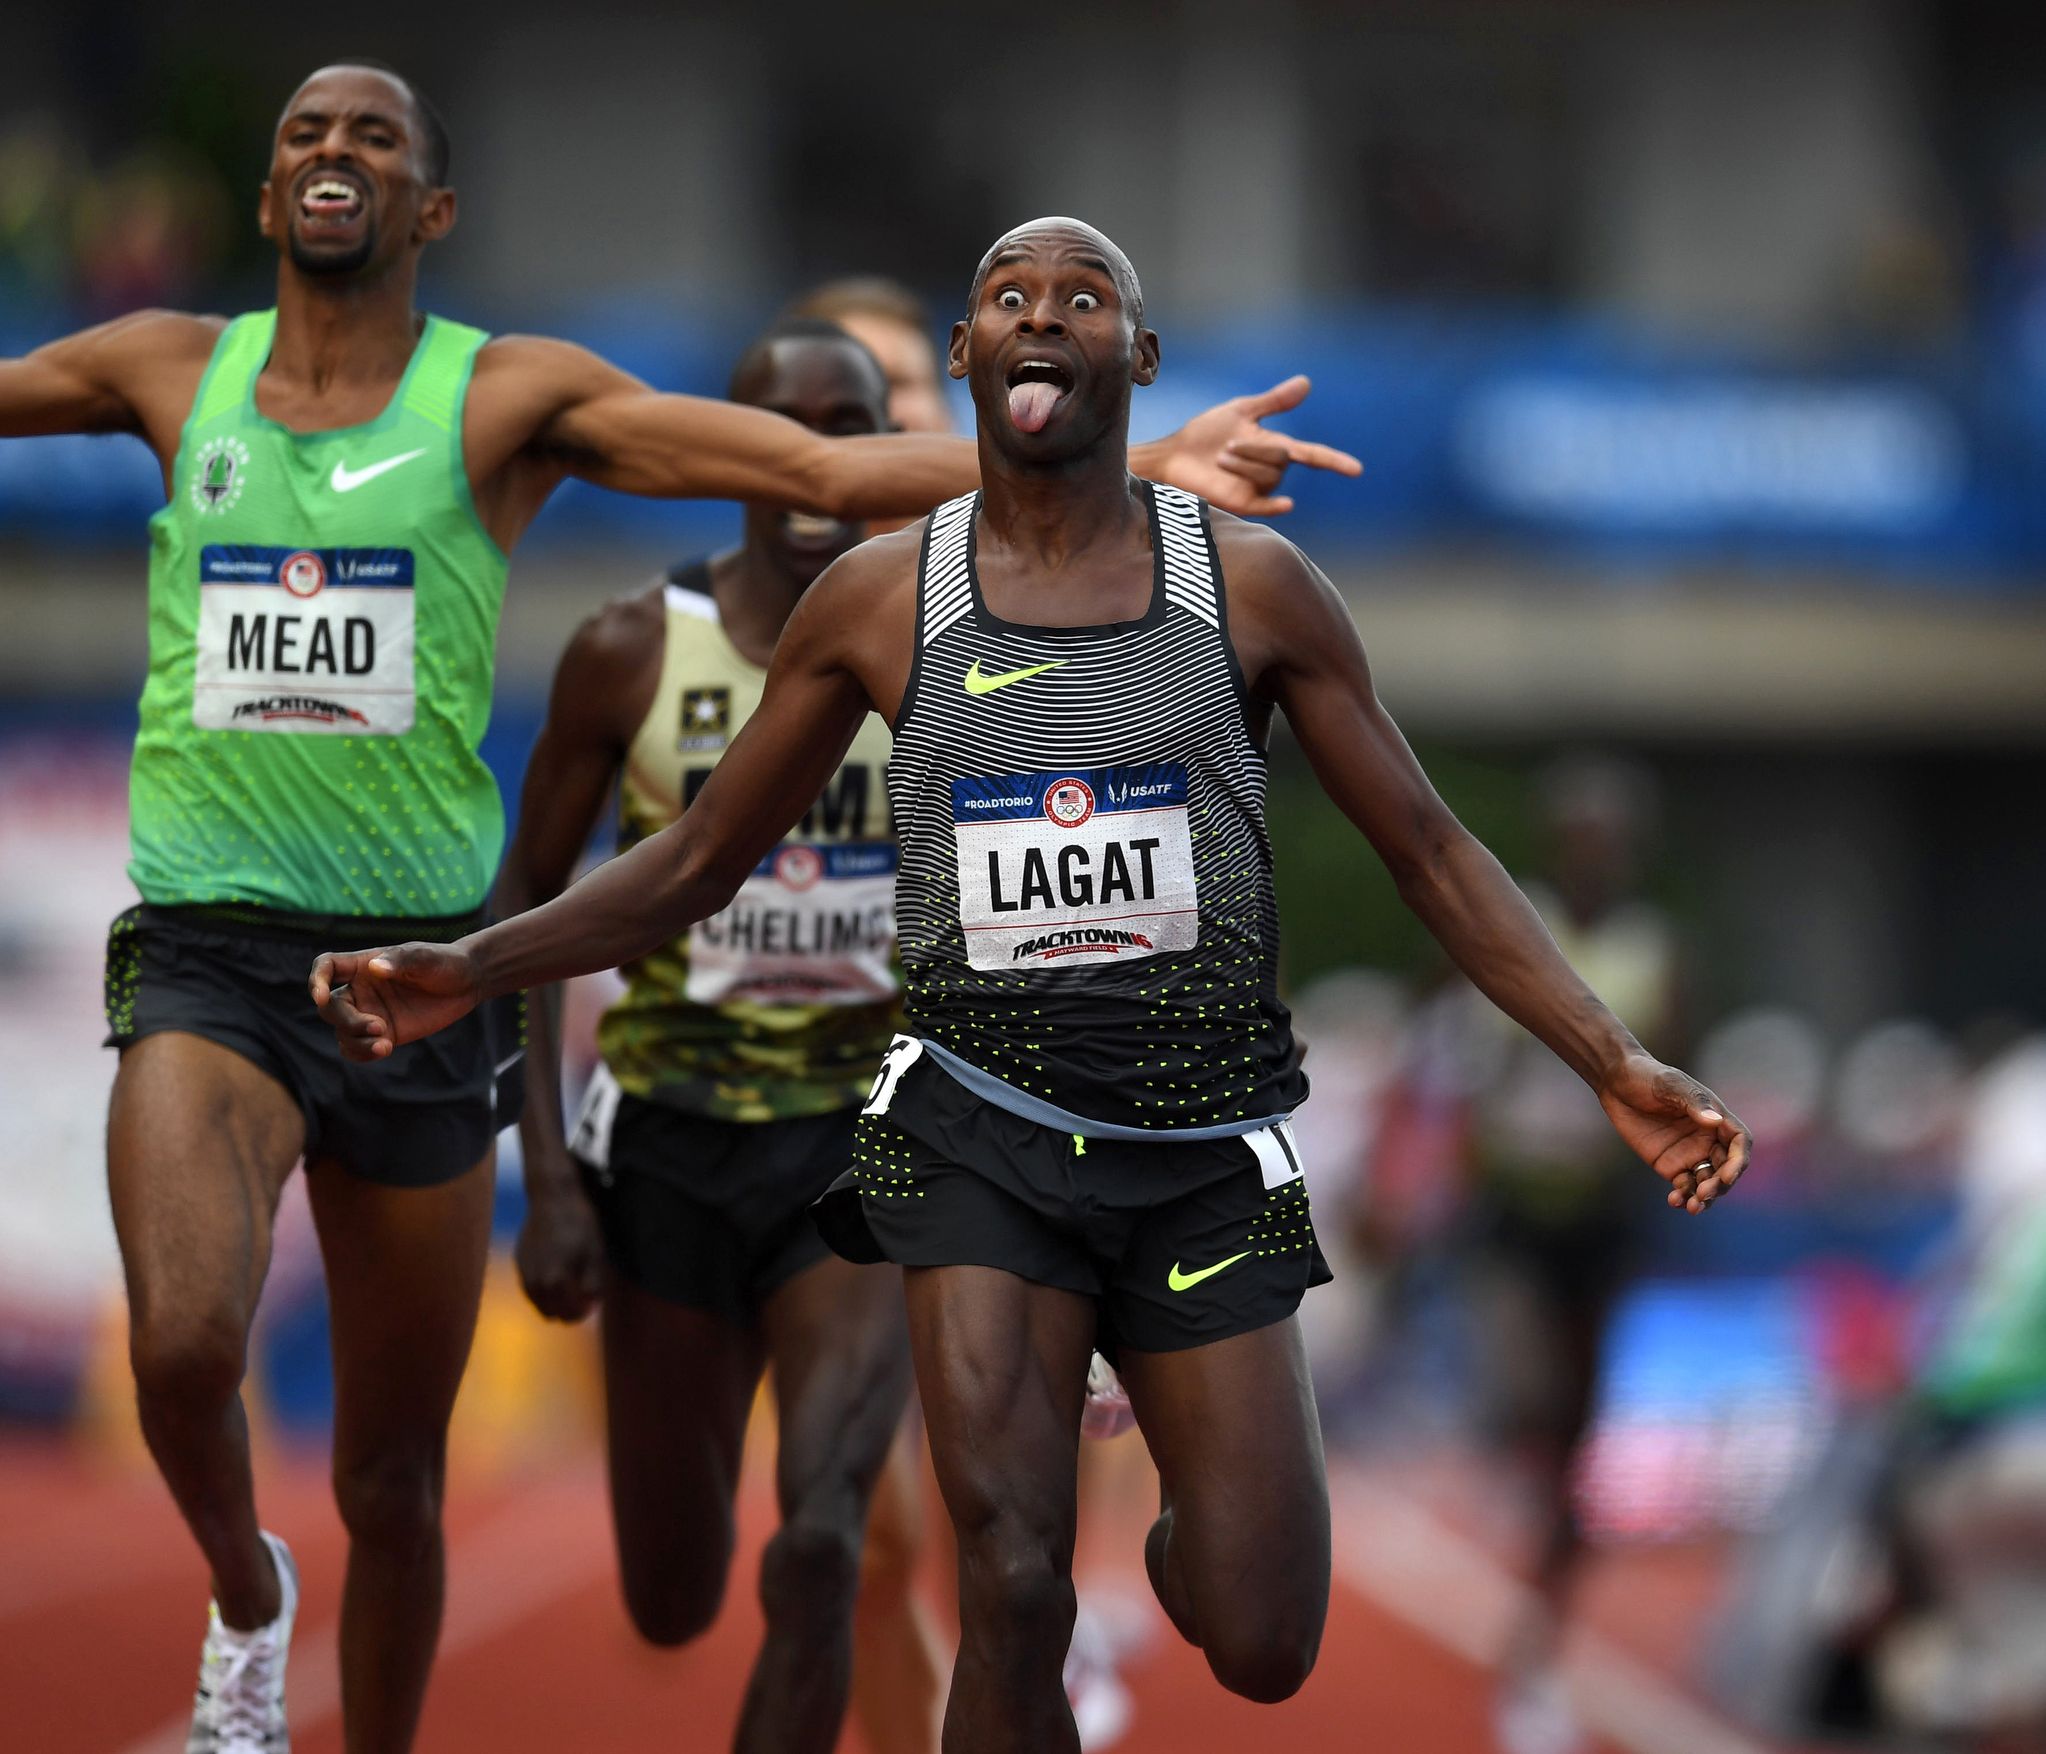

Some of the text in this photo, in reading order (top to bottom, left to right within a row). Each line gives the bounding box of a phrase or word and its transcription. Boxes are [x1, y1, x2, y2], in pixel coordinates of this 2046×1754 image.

[228, 613, 376, 676] MEAD
[1048, 780, 1089, 797] UNITED STATES
[1130, 783, 1173, 798] USATF
[964, 796, 1034, 810] #ROADTORIO
[1048, 807, 1092, 827] OLYMPIC TEAM
[987, 837, 1160, 913] LAGAT
[1054, 945, 1089, 956] HAYWARD
